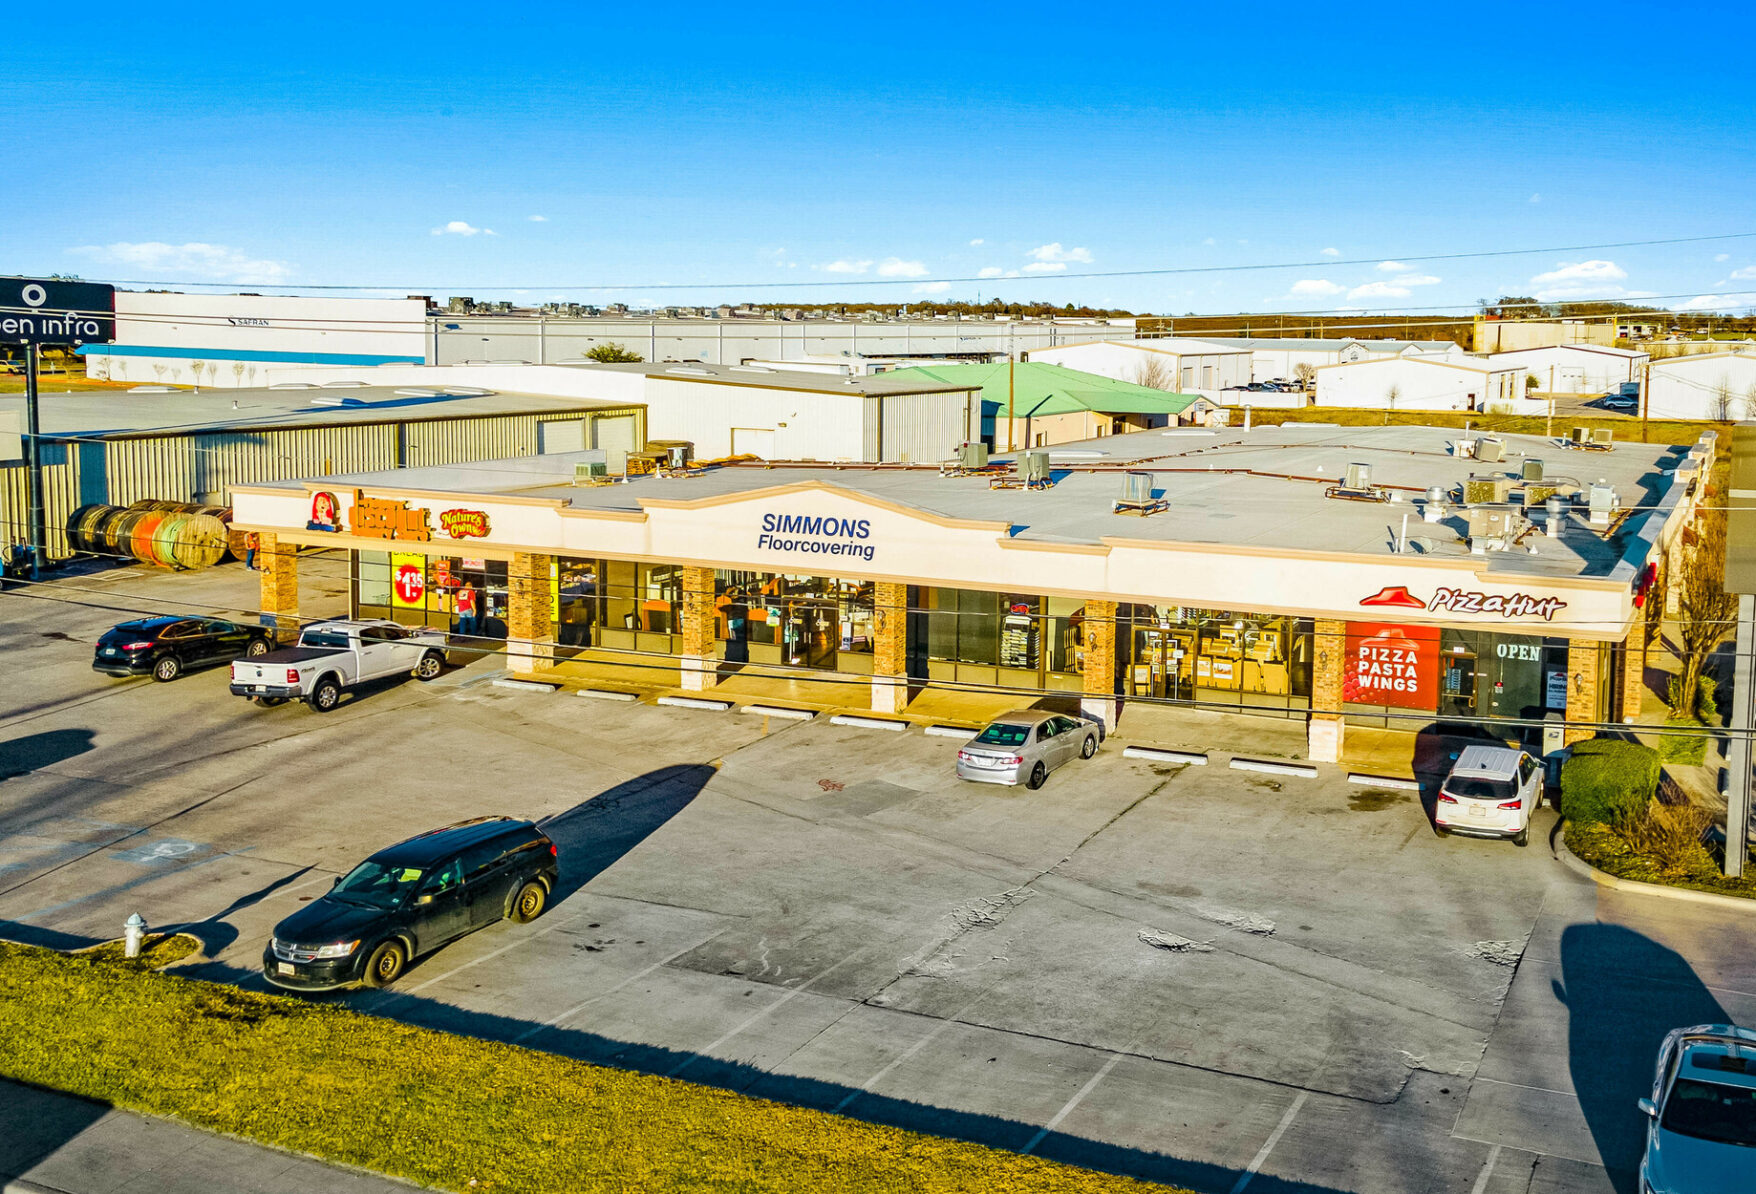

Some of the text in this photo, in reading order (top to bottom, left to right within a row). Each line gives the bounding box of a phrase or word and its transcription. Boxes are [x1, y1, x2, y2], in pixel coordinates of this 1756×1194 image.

[0, 312, 99, 335] en infra
[238, 318, 269, 326] SAFRAN
[762, 513, 870, 539] SIMMONS
[758, 534, 875, 561] Floorcovering
[1359, 647, 1418, 664] PIZZA
[1497, 644, 1541, 661] OPEN
[1358, 661, 1417, 678] PASTA
[1358, 675, 1418, 692] WINGS
